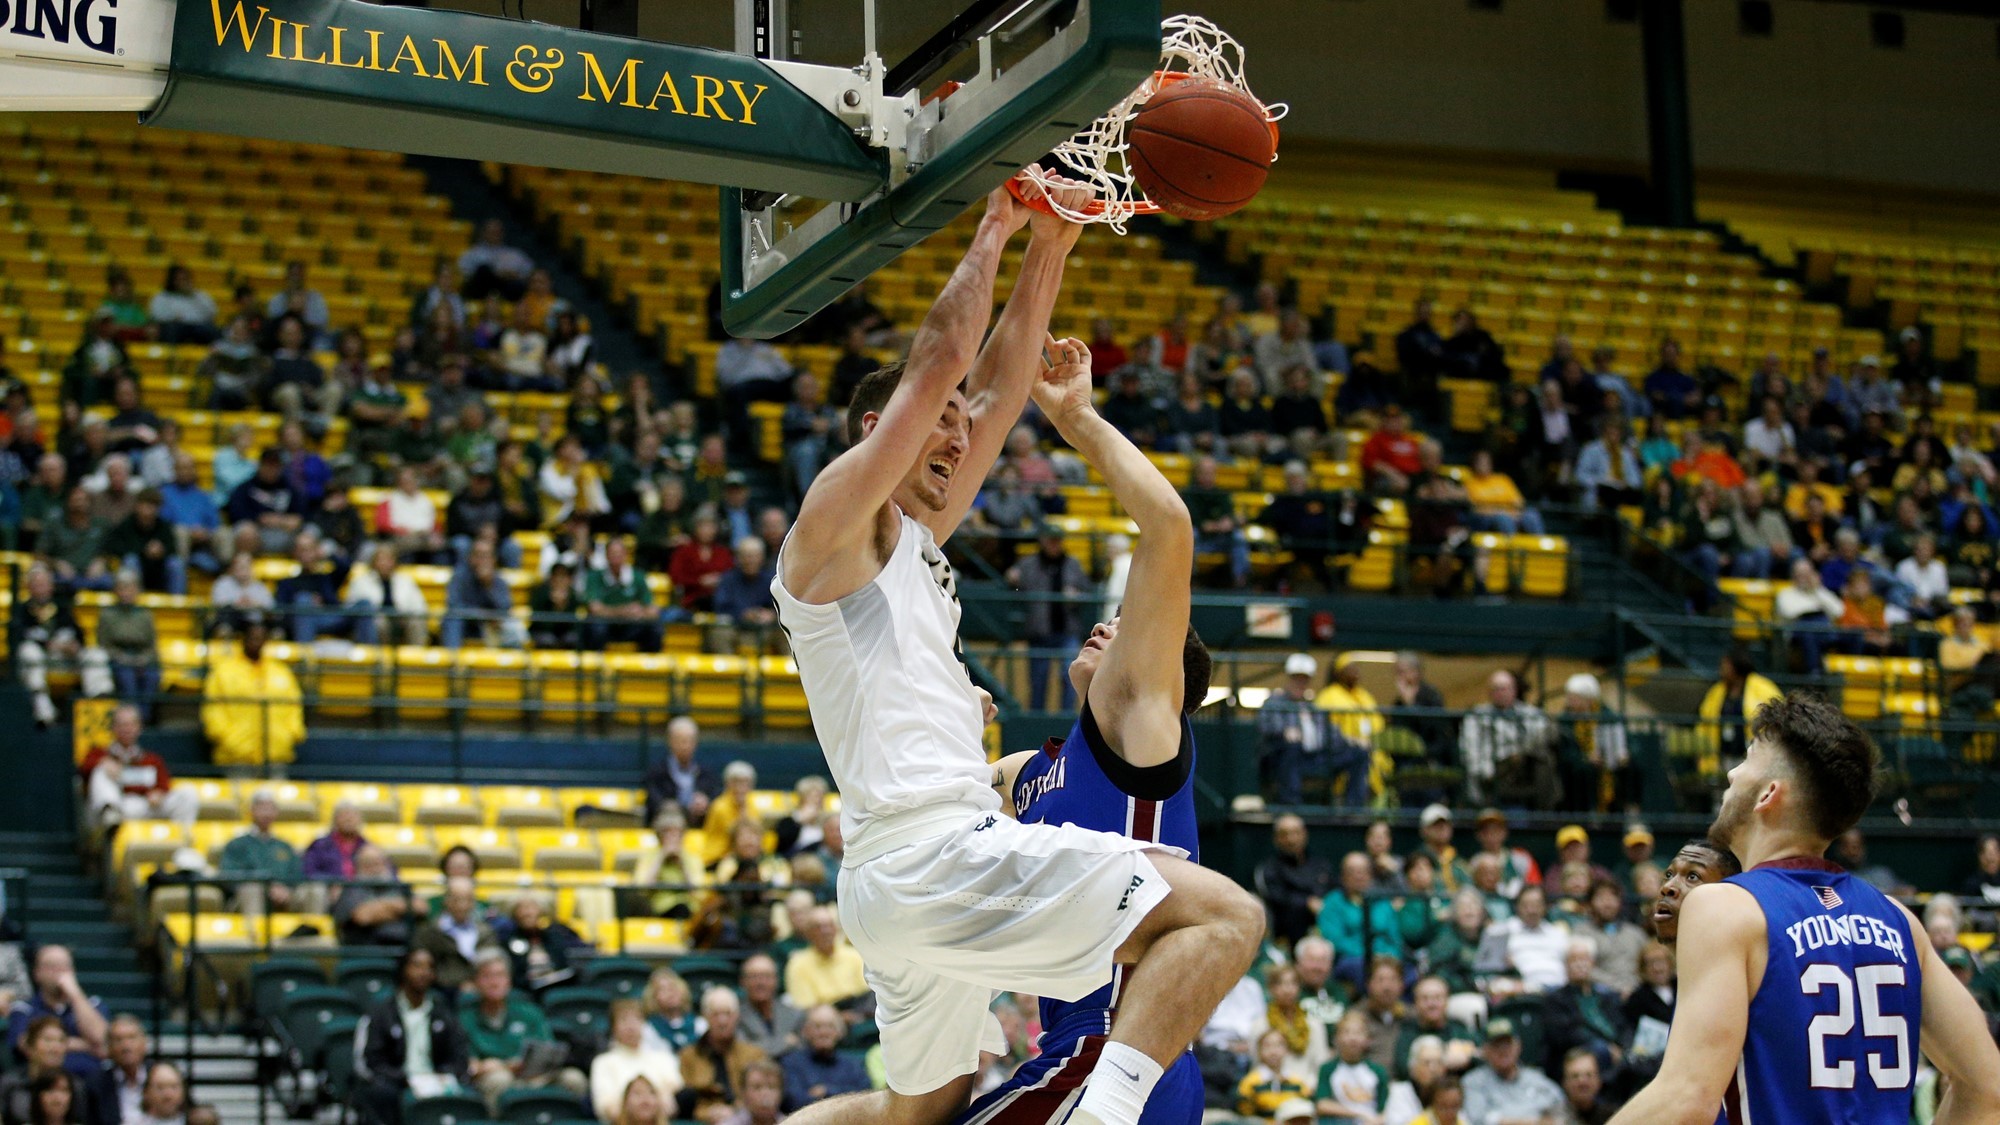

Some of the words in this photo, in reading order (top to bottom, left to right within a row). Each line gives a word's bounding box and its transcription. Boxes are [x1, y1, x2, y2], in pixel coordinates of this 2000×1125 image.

[209, 0, 489, 86] WILLIAM
[505, 44, 564, 93] &
[577, 51, 768, 125] MARY
[1786, 914, 1908, 963] YOUNGER
[1800, 963, 1912, 1089] 25
